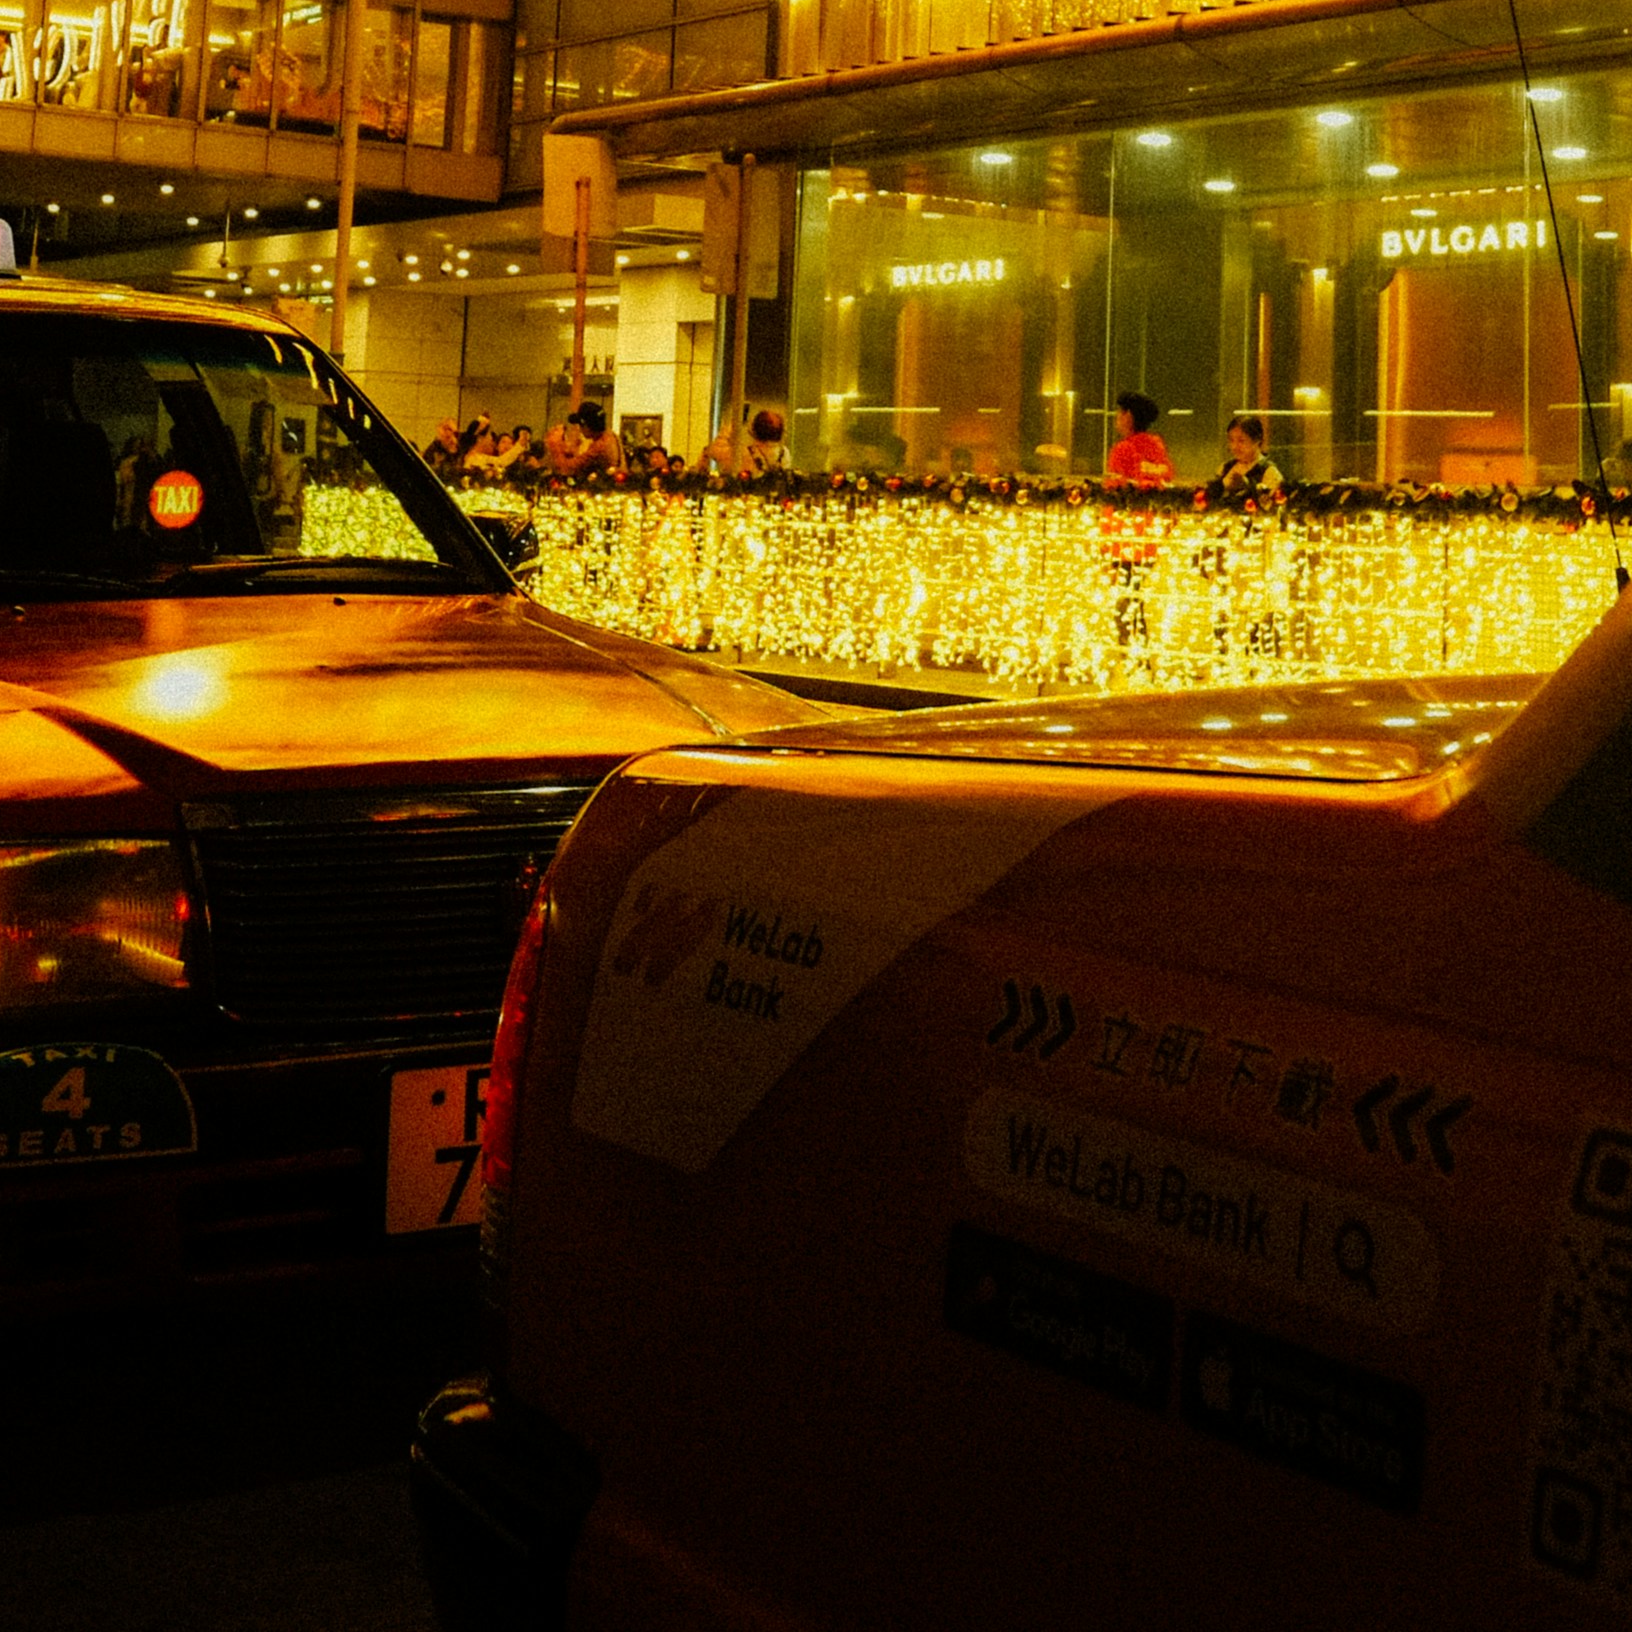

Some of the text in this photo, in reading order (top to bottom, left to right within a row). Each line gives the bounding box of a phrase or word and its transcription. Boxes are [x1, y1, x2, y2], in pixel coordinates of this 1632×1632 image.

[1381, 220, 1546, 258] BVLGARI
[891, 257, 1005, 288] BVLGARI
[154, 485, 199, 514] TAXI
[723, 904, 823, 969] WeLab
[706, 959, 784, 1020] Bank
[10, 1046, 116, 1068] TAXI
[1090, 1008, 1334, 1132] 立即下載
[40, 1066, 93, 1120] 4
[1008, 1116, 1267, 1256] WeLab Bank
[1008, 1290, 1157, 1390] Google Play
[1242, 1386, 1310, 1451] App
[1317, 1410, 1403, 1485] Store
